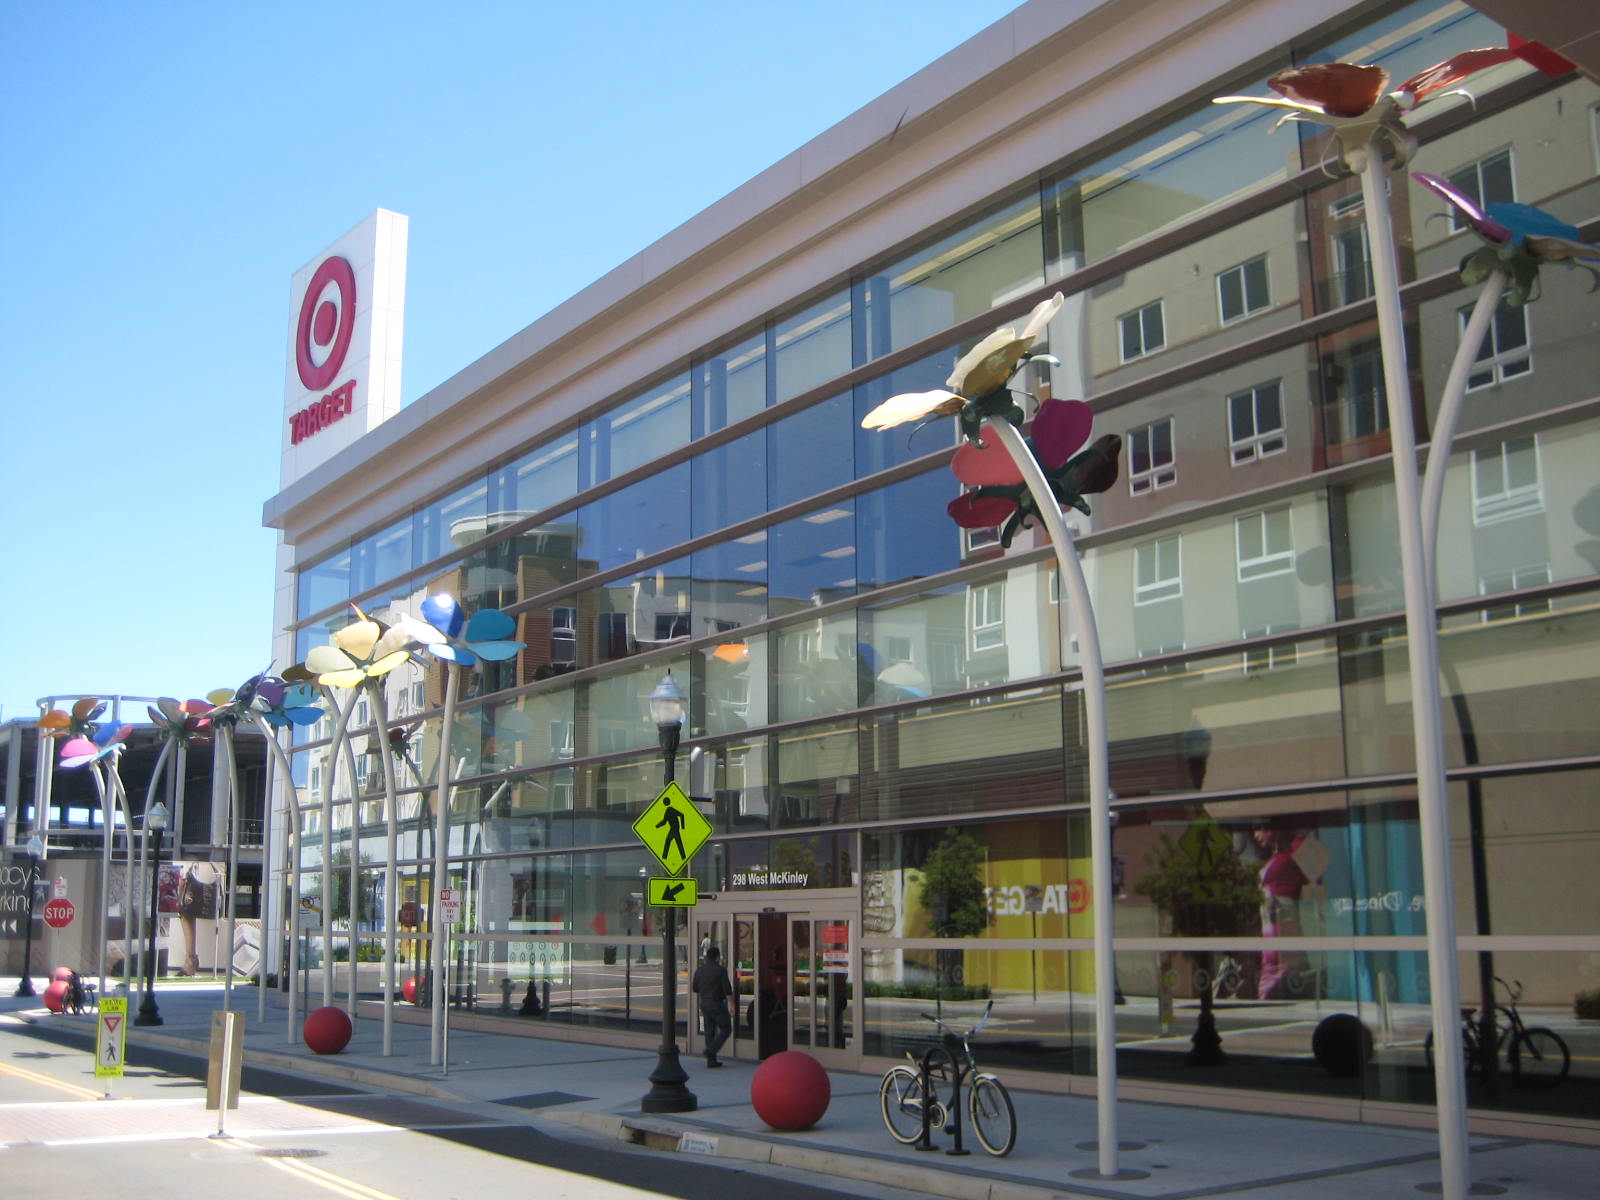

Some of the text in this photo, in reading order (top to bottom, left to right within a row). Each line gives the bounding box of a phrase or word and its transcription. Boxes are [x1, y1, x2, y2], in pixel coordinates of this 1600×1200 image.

[289, 379, 357, 445] TARGET
[732, 871, 809, 887] 298 West McKinley
[442, 890, 450, 899] NO
[45, 907, 74, 920] STOP
